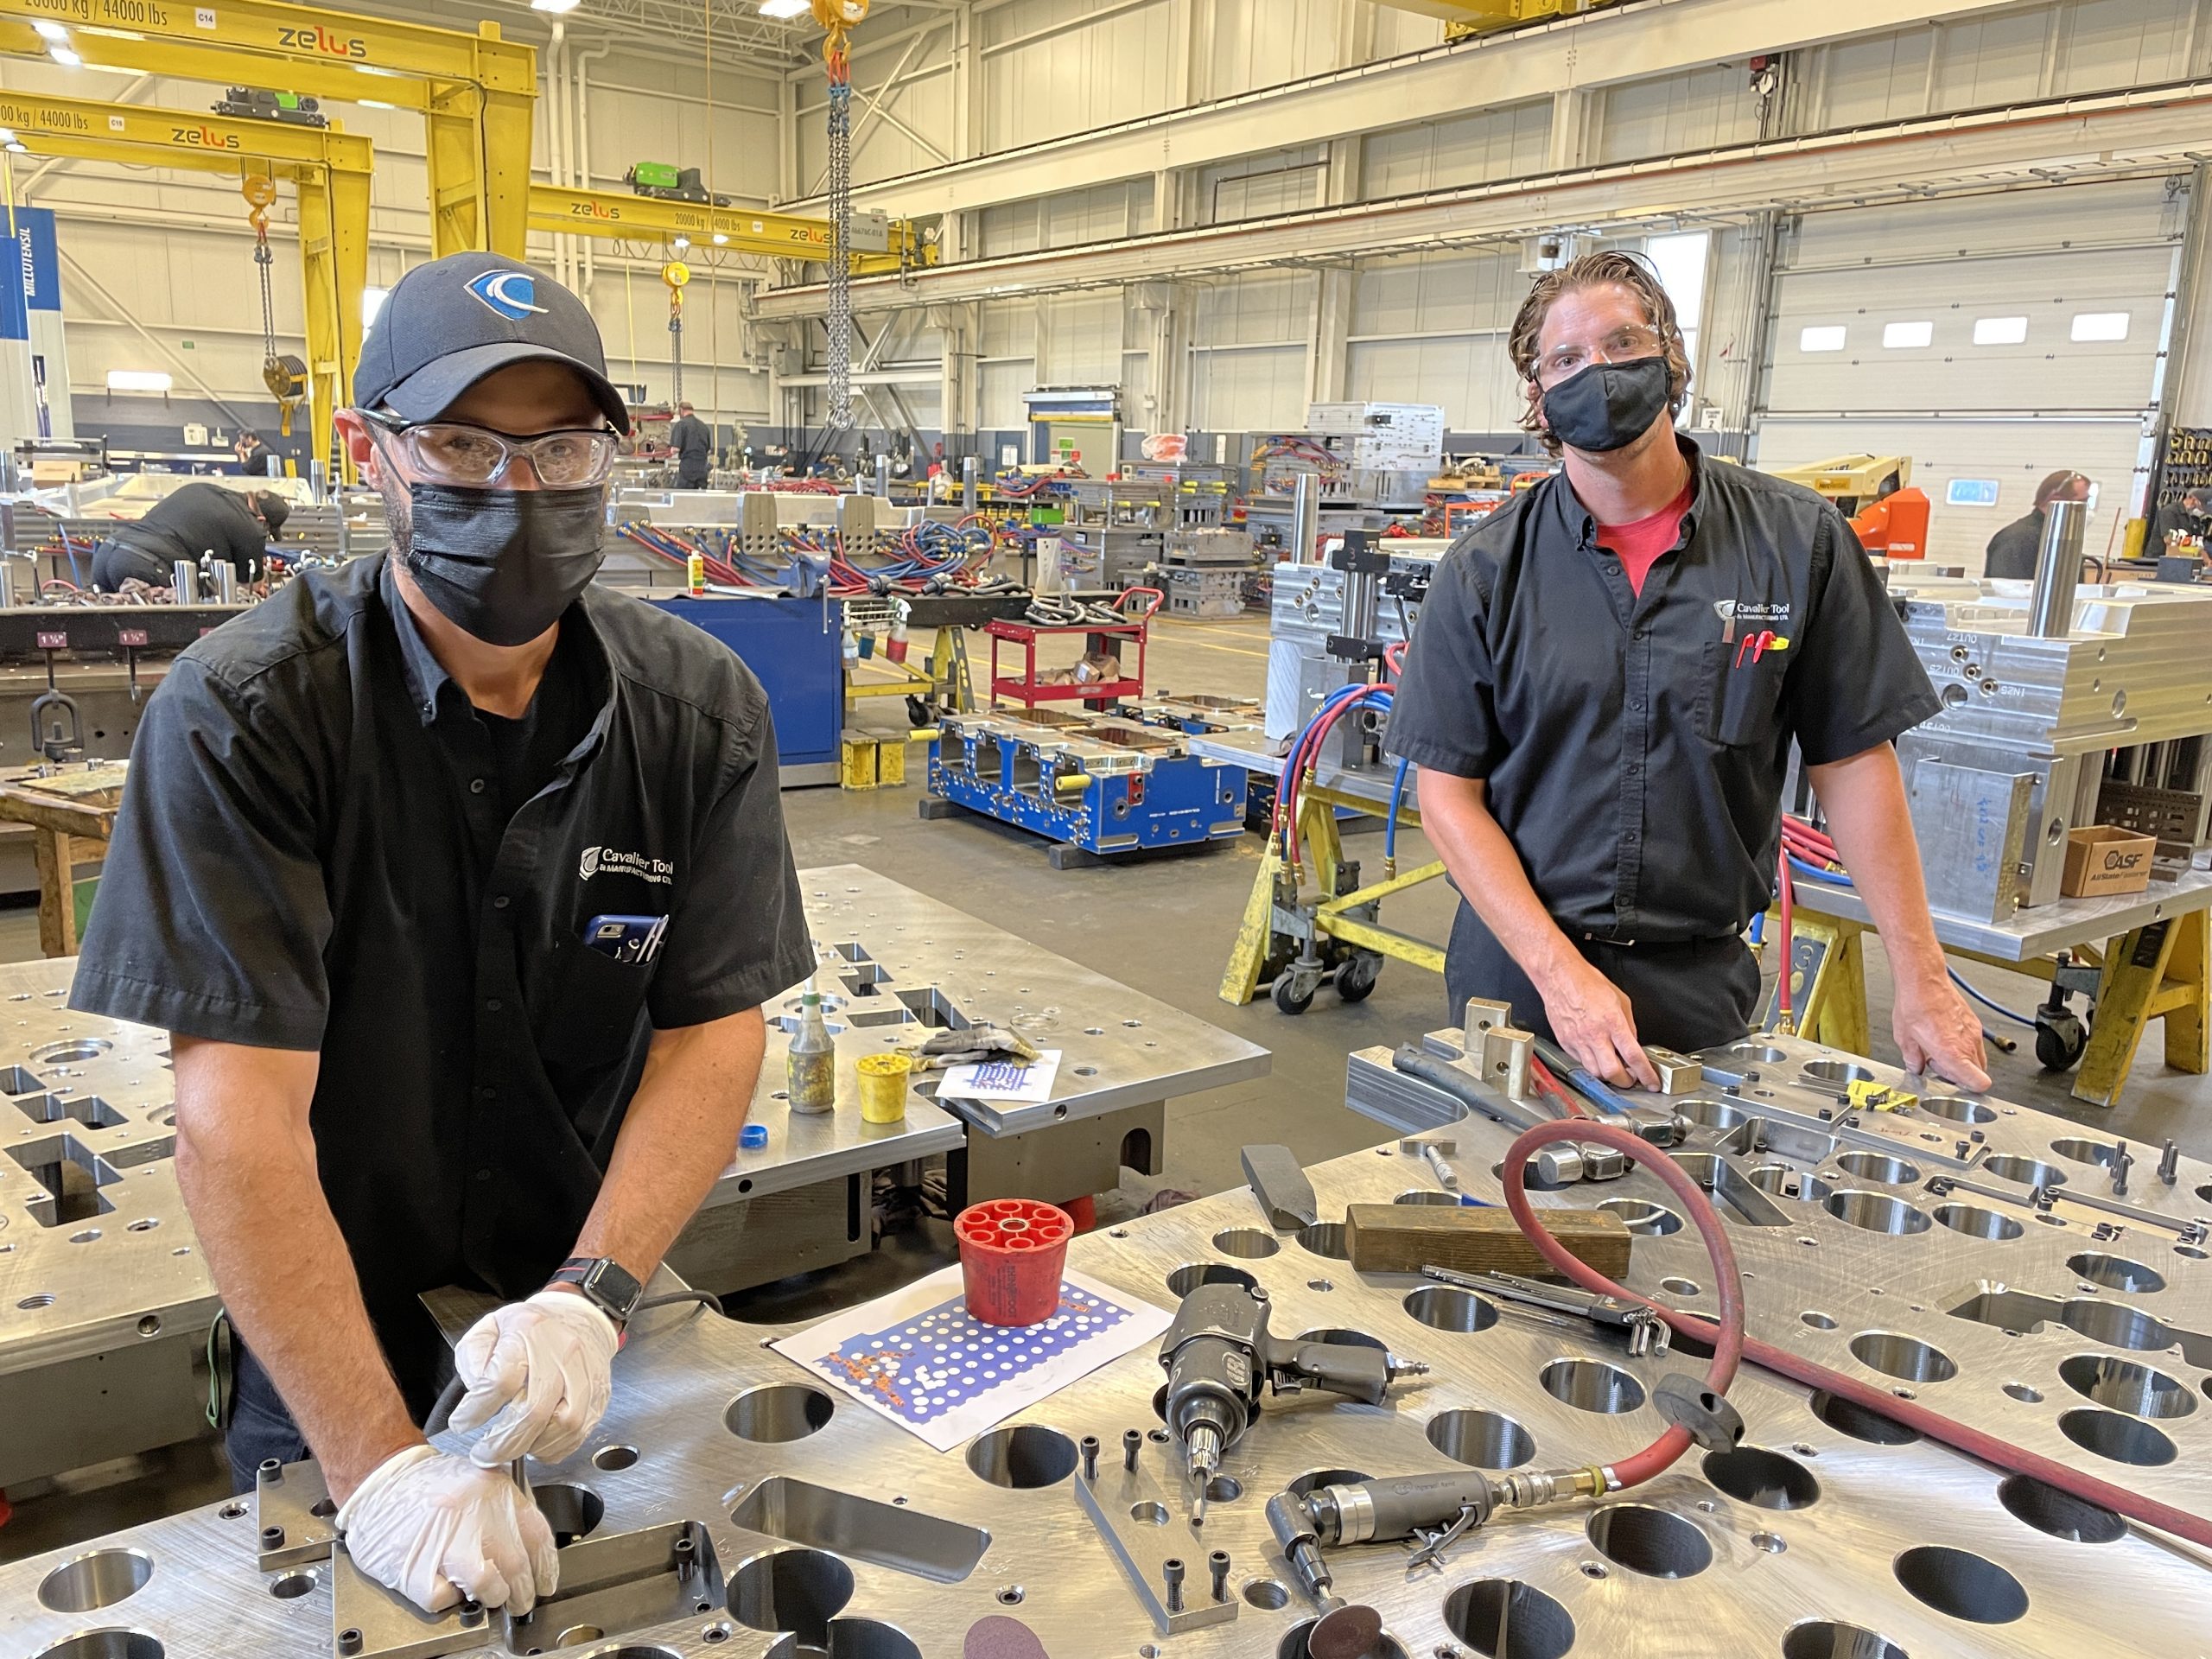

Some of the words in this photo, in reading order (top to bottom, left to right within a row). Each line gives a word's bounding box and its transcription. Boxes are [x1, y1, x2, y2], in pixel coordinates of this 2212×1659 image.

[104, 0, 144, 22] 44000
[149, 5, 168, 26] lbs
[198, 14, 213, 22] C14
[278, 25, 367, 58] zelus
[16, 106, 30, 127] kg
[40, 110, 71, 128] 44000
[73, 112, 89, 130] lbs
[171, 124, 240, 149] zelus
[570, 200, 621, 220] zelus
[675, 213, 696, 226] 20000
[696, 214, 705, 230] kg
[731, 219, 741, 232] lbs
[790, 227, 832, 244] zelus
[1770, 603, 1790, 614] Tool
[602, 848, 651, 870] Cavalier
[652, 859, 674, 875] Tool
